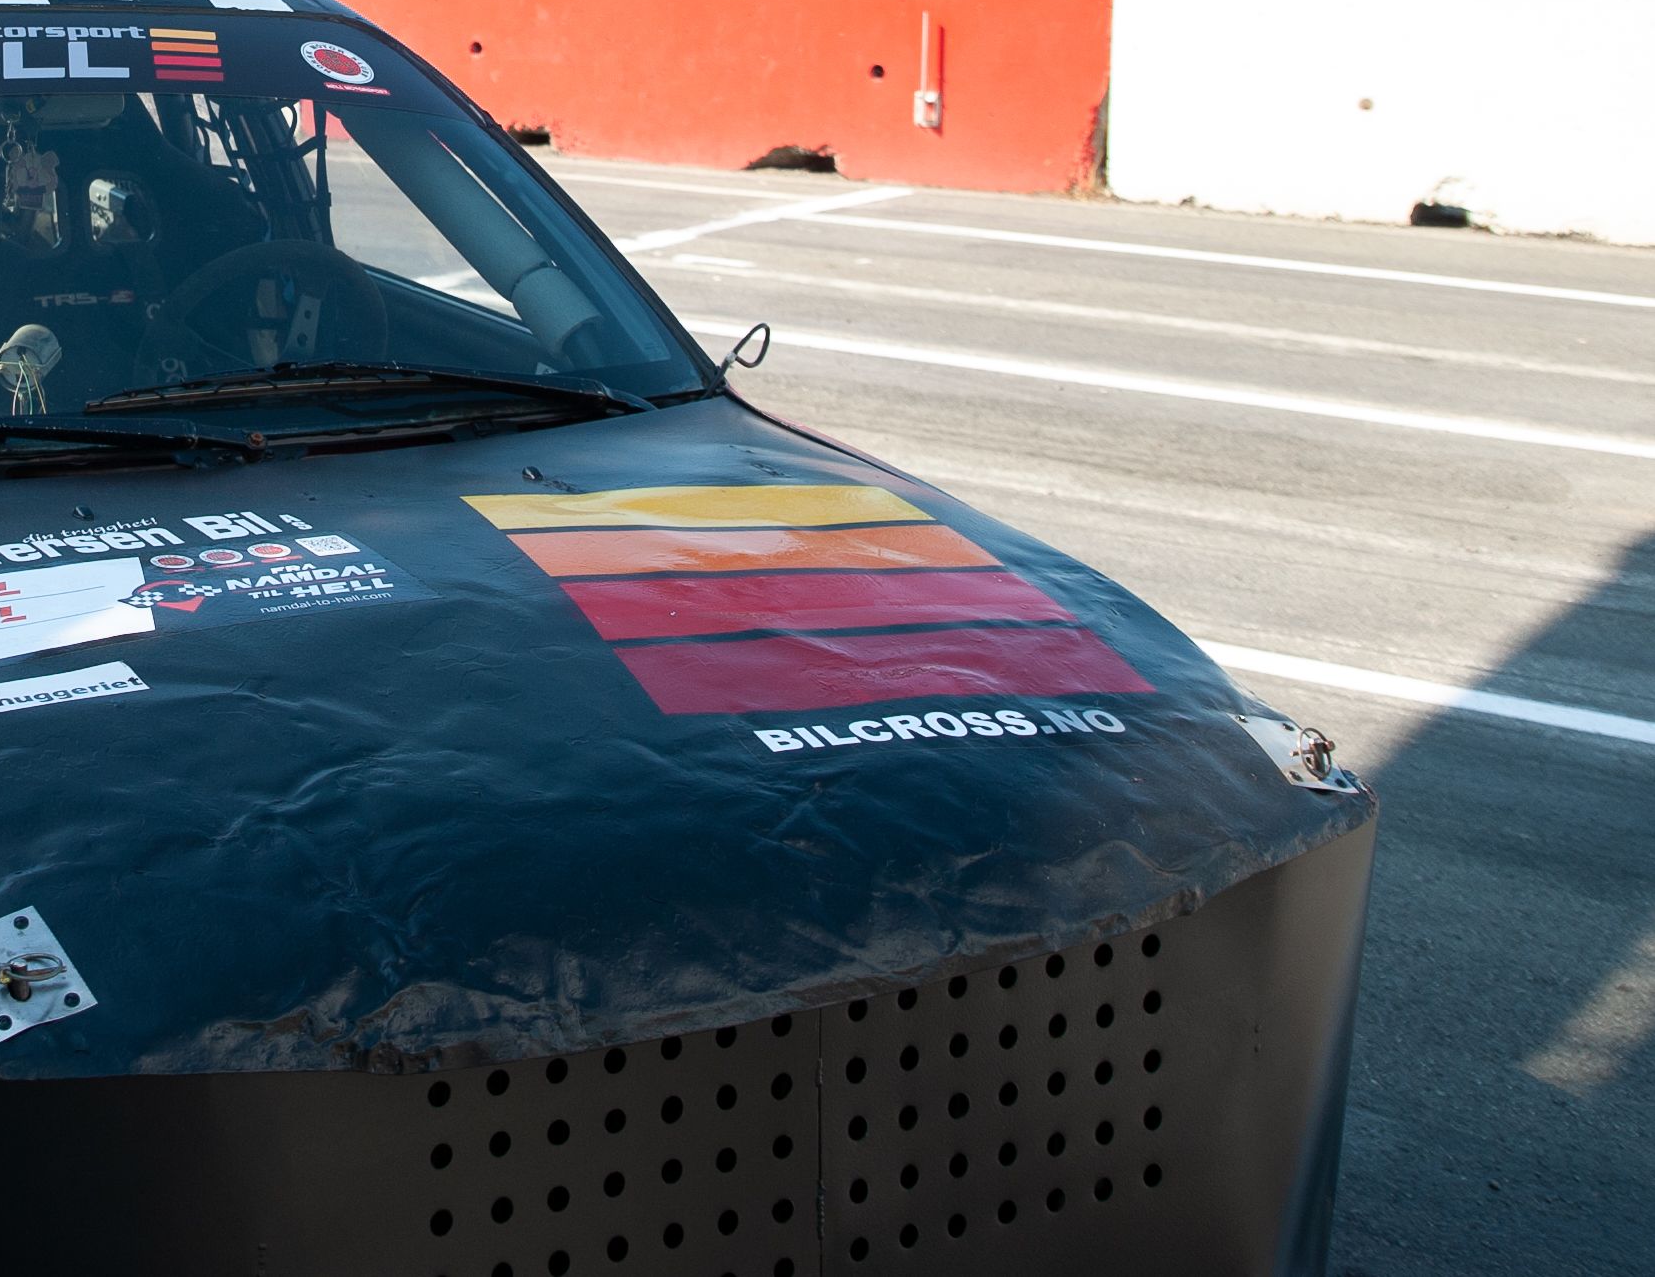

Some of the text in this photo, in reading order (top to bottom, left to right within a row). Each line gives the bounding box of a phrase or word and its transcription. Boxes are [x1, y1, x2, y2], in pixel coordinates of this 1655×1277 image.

[183, 511, 282, 541] Bil
[22, 533, 54, 544] din
[226, 563, 386, 590] NAMDAL
[270, 563, 317, 575] FRA
[248, 577, 394, 600] TIL HELL
[260, 592, 392, 614] namdal-to-hell.com
[753, 709, 1127, 753] BILCROSS.NO
